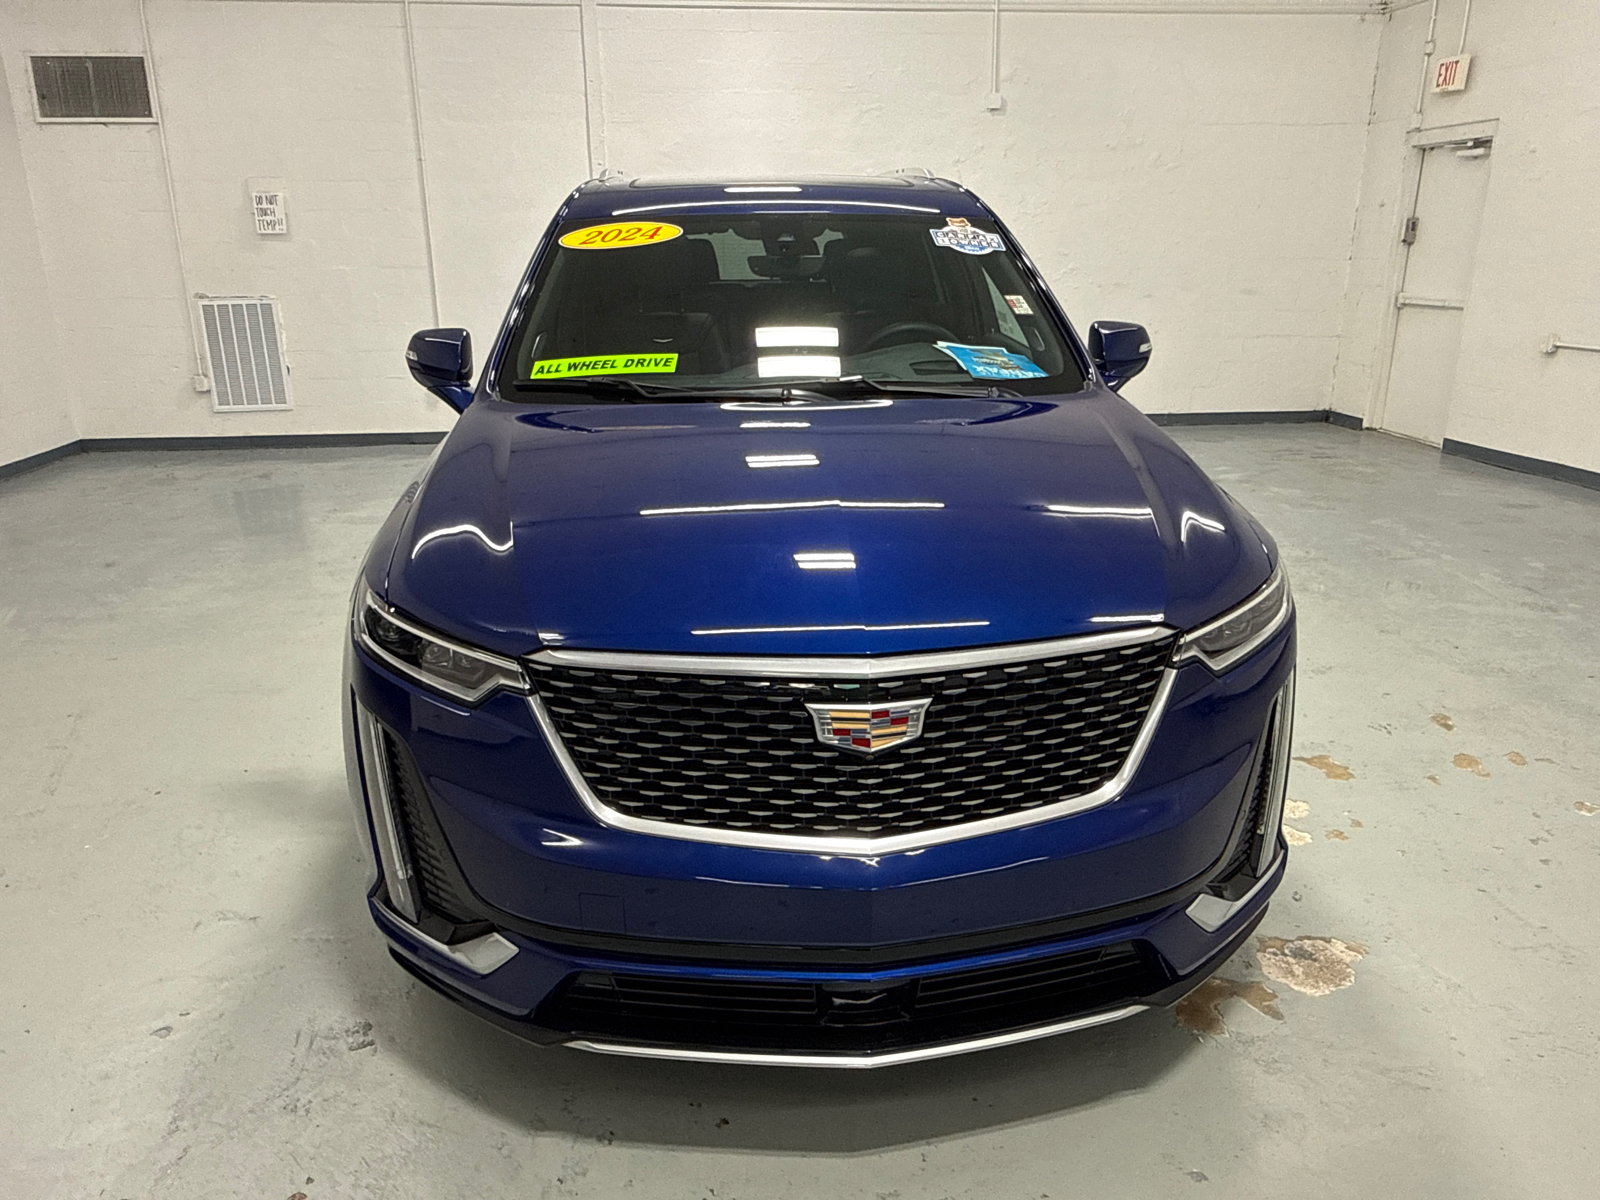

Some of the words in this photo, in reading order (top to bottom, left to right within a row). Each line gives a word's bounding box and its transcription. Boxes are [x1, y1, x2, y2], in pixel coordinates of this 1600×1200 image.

[1436, 60, 1460, 88] EXIT
[255, 195, 263, 206] DO
[265, 194, 278, 206] NOT
[255, 207, 276, 217] TOUCH
[257, 218, 284, 231] TEMP!!
[578, 226, 663, 245] 2024
[936, 231, 999, 243] CARFAX
[534, 363, 563, 376] ALL
[567, 359, 618, 372] WHEEL
[622, 357, 675, 369] DRIVE
